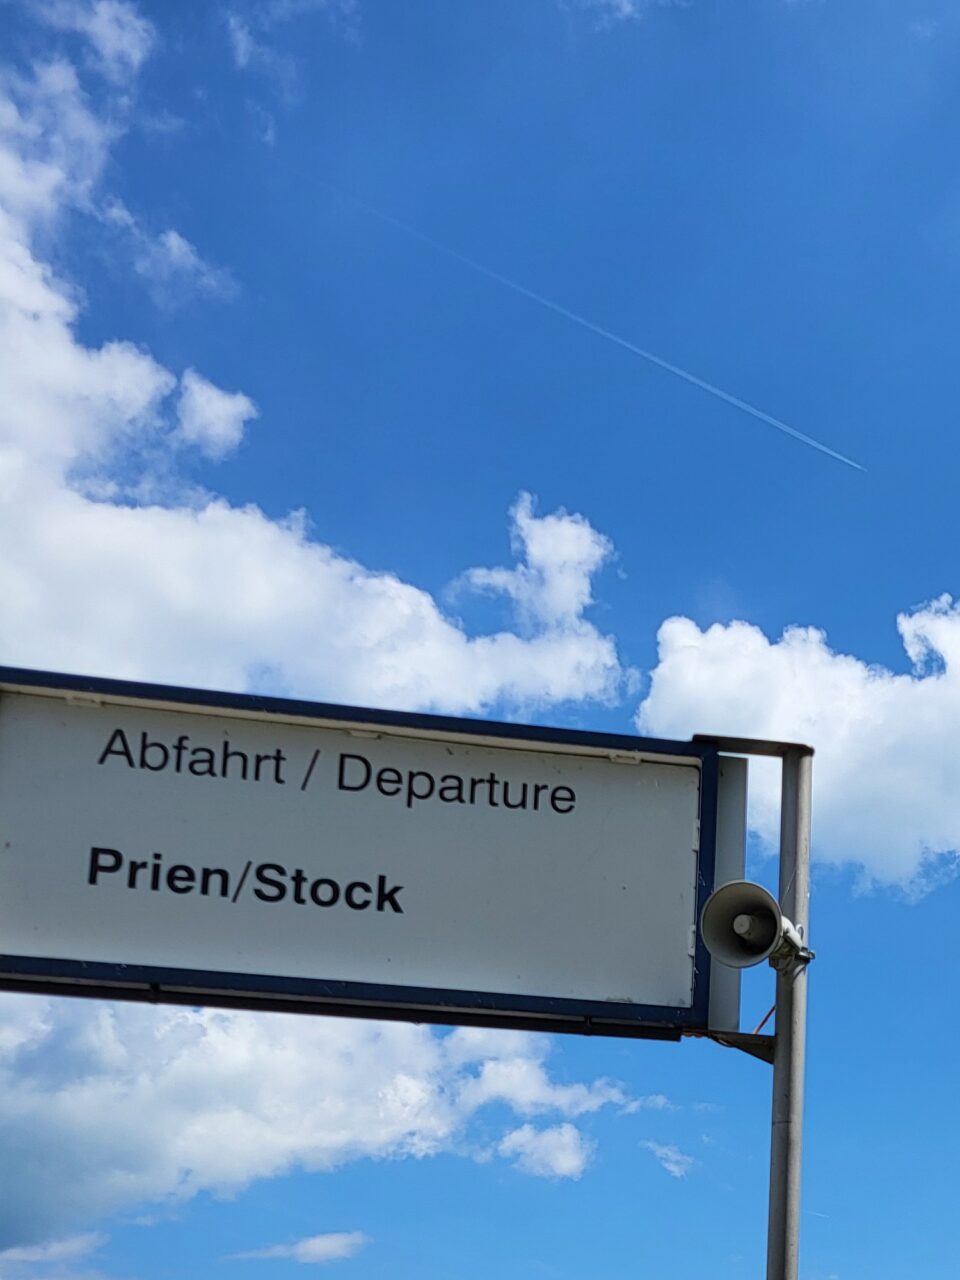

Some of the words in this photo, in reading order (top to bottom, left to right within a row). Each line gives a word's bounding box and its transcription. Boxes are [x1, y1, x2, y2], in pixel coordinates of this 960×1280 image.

[98, 728, 287, 785] Abfahrt
[300, 749, 321, 791] /
[337, 752, 577, 814] Departure
[87, 846, 405, 914] Prien/Stock
